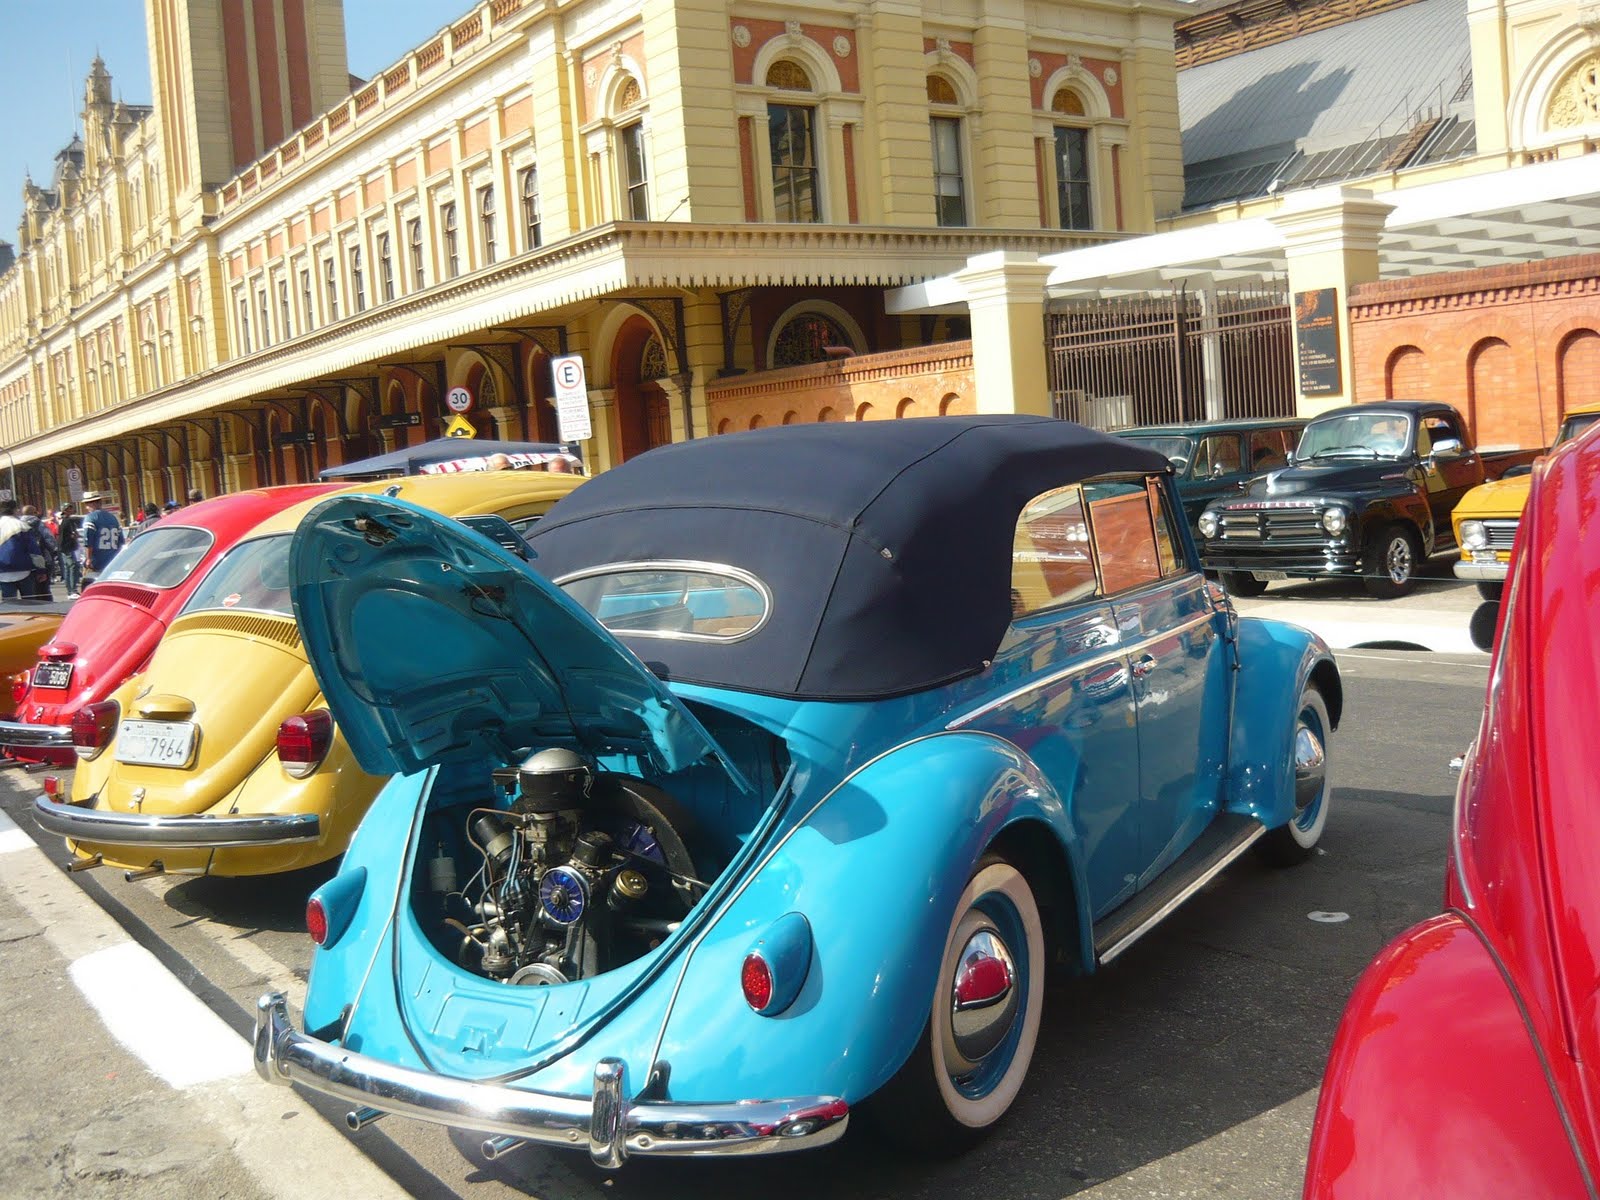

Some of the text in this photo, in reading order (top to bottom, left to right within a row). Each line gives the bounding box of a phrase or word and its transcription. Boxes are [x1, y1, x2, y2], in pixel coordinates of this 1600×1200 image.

[563, 366, 574, 383] E
[452, 392, 468, 405] 30
[149, 737, 185, 759] 7964
